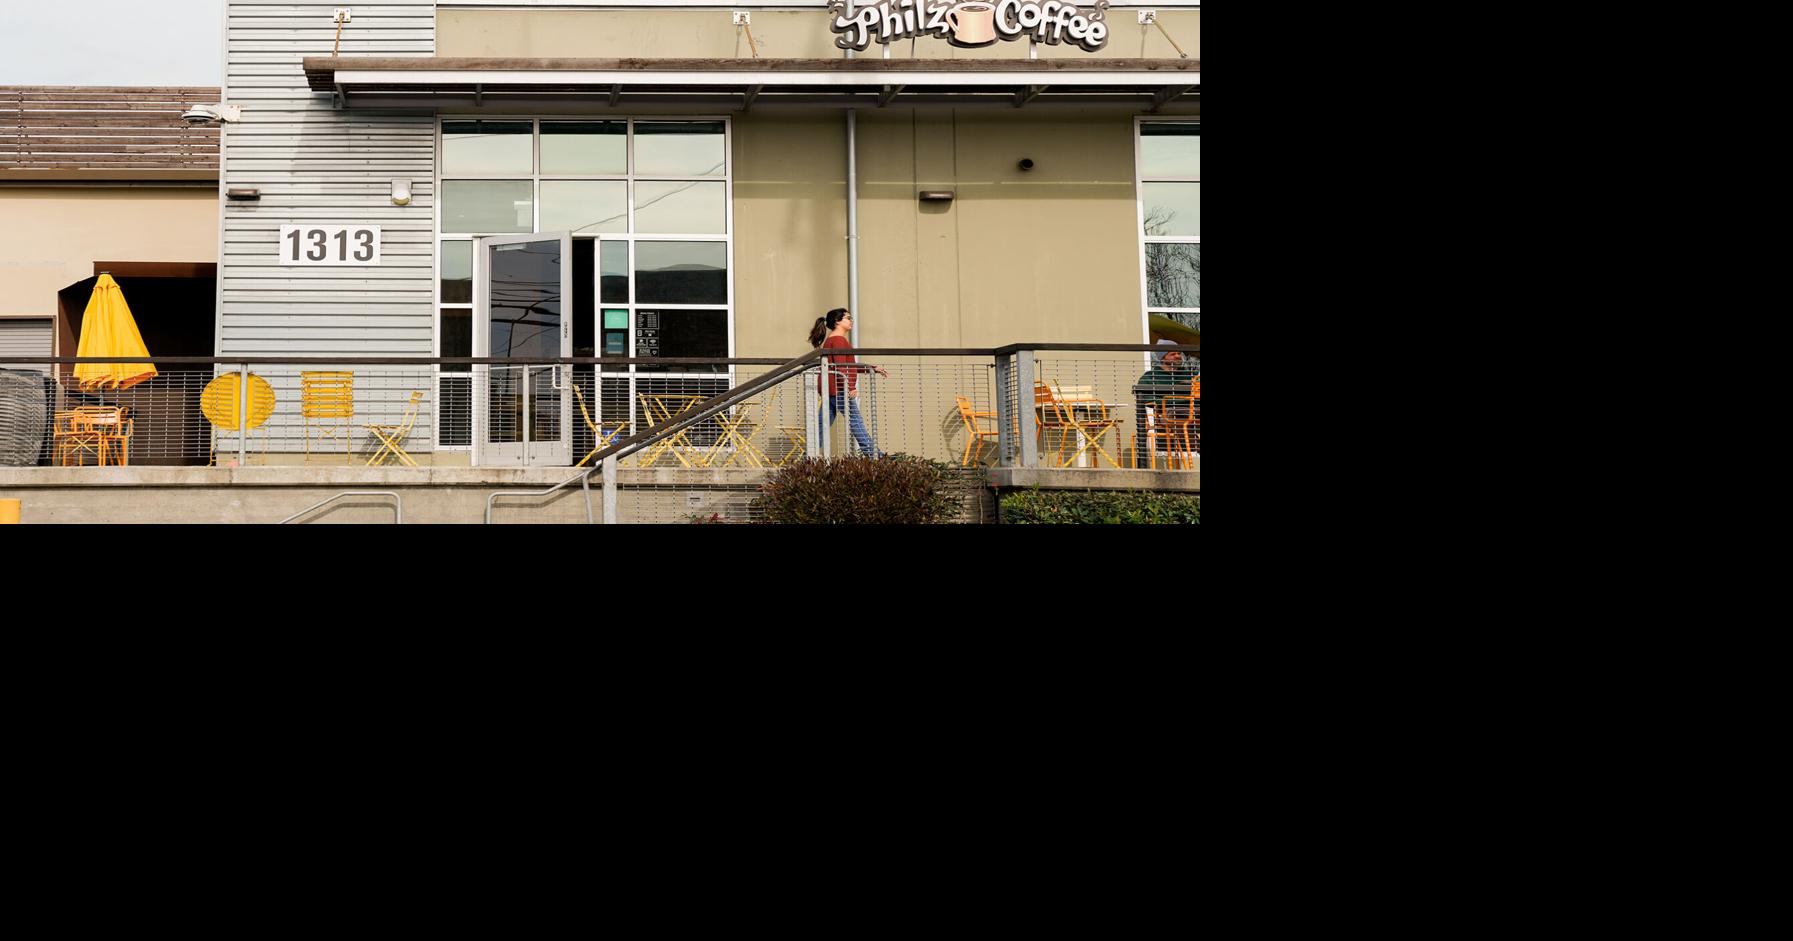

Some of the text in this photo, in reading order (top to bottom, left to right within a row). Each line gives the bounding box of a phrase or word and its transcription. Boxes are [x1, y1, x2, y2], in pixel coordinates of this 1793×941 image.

[835, 0, 1107, 46] Philz Coffee
[287, 229, 374, 262] 1313
